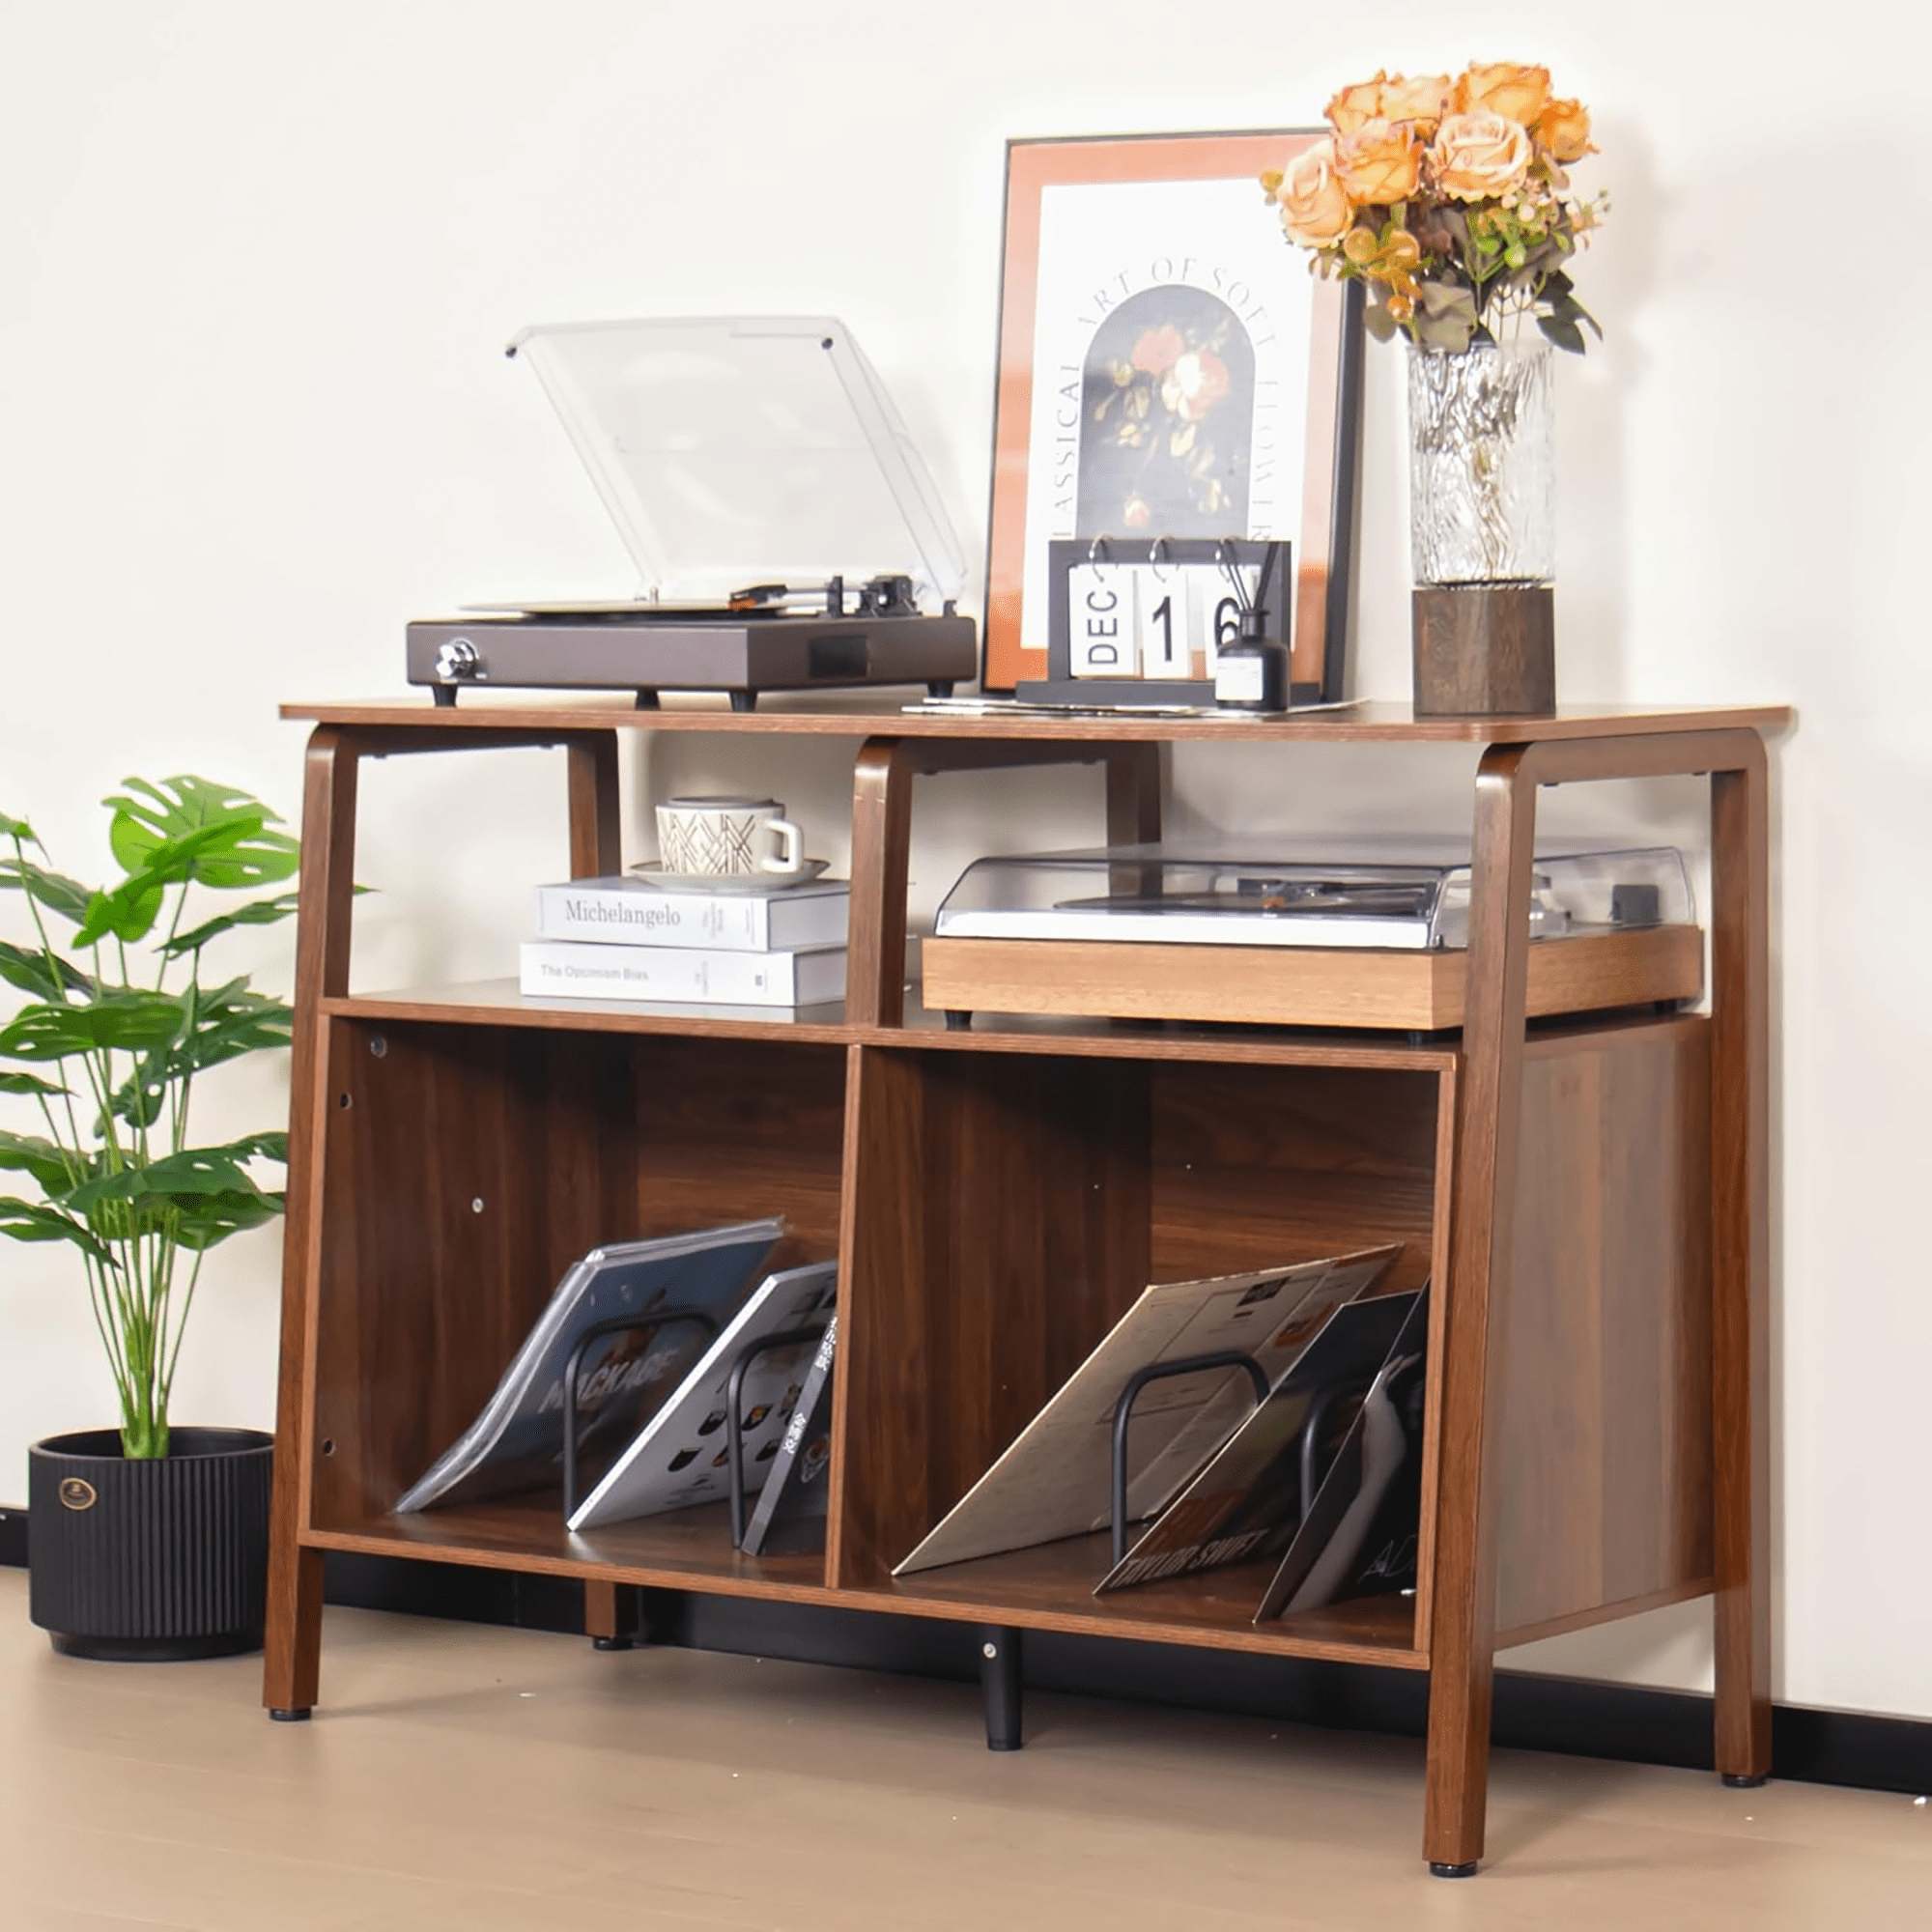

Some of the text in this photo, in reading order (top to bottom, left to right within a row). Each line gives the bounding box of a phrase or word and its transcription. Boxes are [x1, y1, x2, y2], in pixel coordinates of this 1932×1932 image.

[1052, 363, 1081, 537] LASSICAL
[1086, 590, 1118, 665] DEC
[1152, 595, 1172, 663] 1
[566, 899, 681, 928] Michelangelo
[540, 964, 562, 977] The
